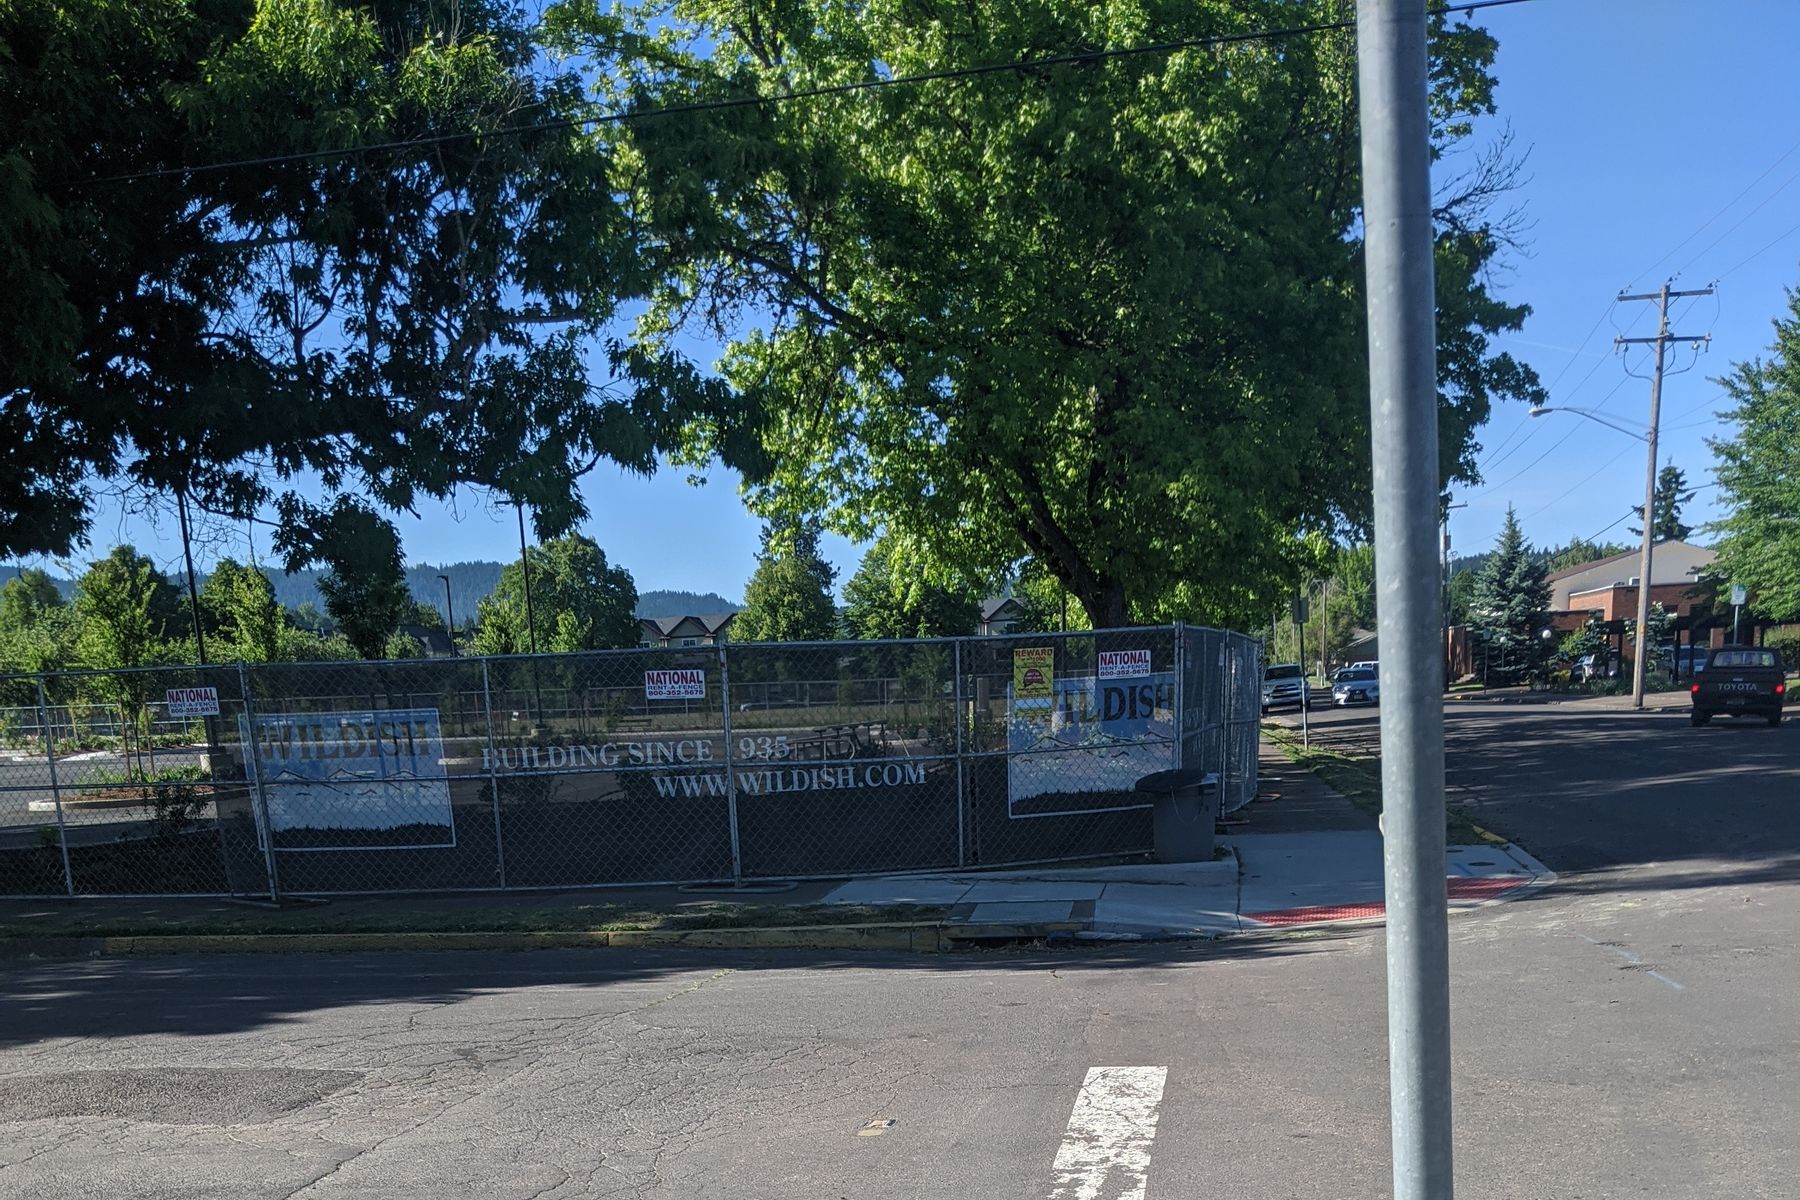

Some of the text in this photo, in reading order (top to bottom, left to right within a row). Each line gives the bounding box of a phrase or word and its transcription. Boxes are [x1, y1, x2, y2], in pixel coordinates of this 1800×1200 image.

[1015, 648, 1053, 657] REWARD
[1100, 651, 1149, 666] NATIONAL
[1100, 663, 1149, 671] RENT-A-FENCE
[646, 670, 703, 686] NATIONAL
[1717, 682, 1758, 691] TOYOTA
[167, 688, 217, 703] NATIONAL
[1054, 683, 1175, 723] ILDISH
[257, 719, 431, 760] WILDISH
[480, 735, 790, 770] BUILDING SINCE 935
